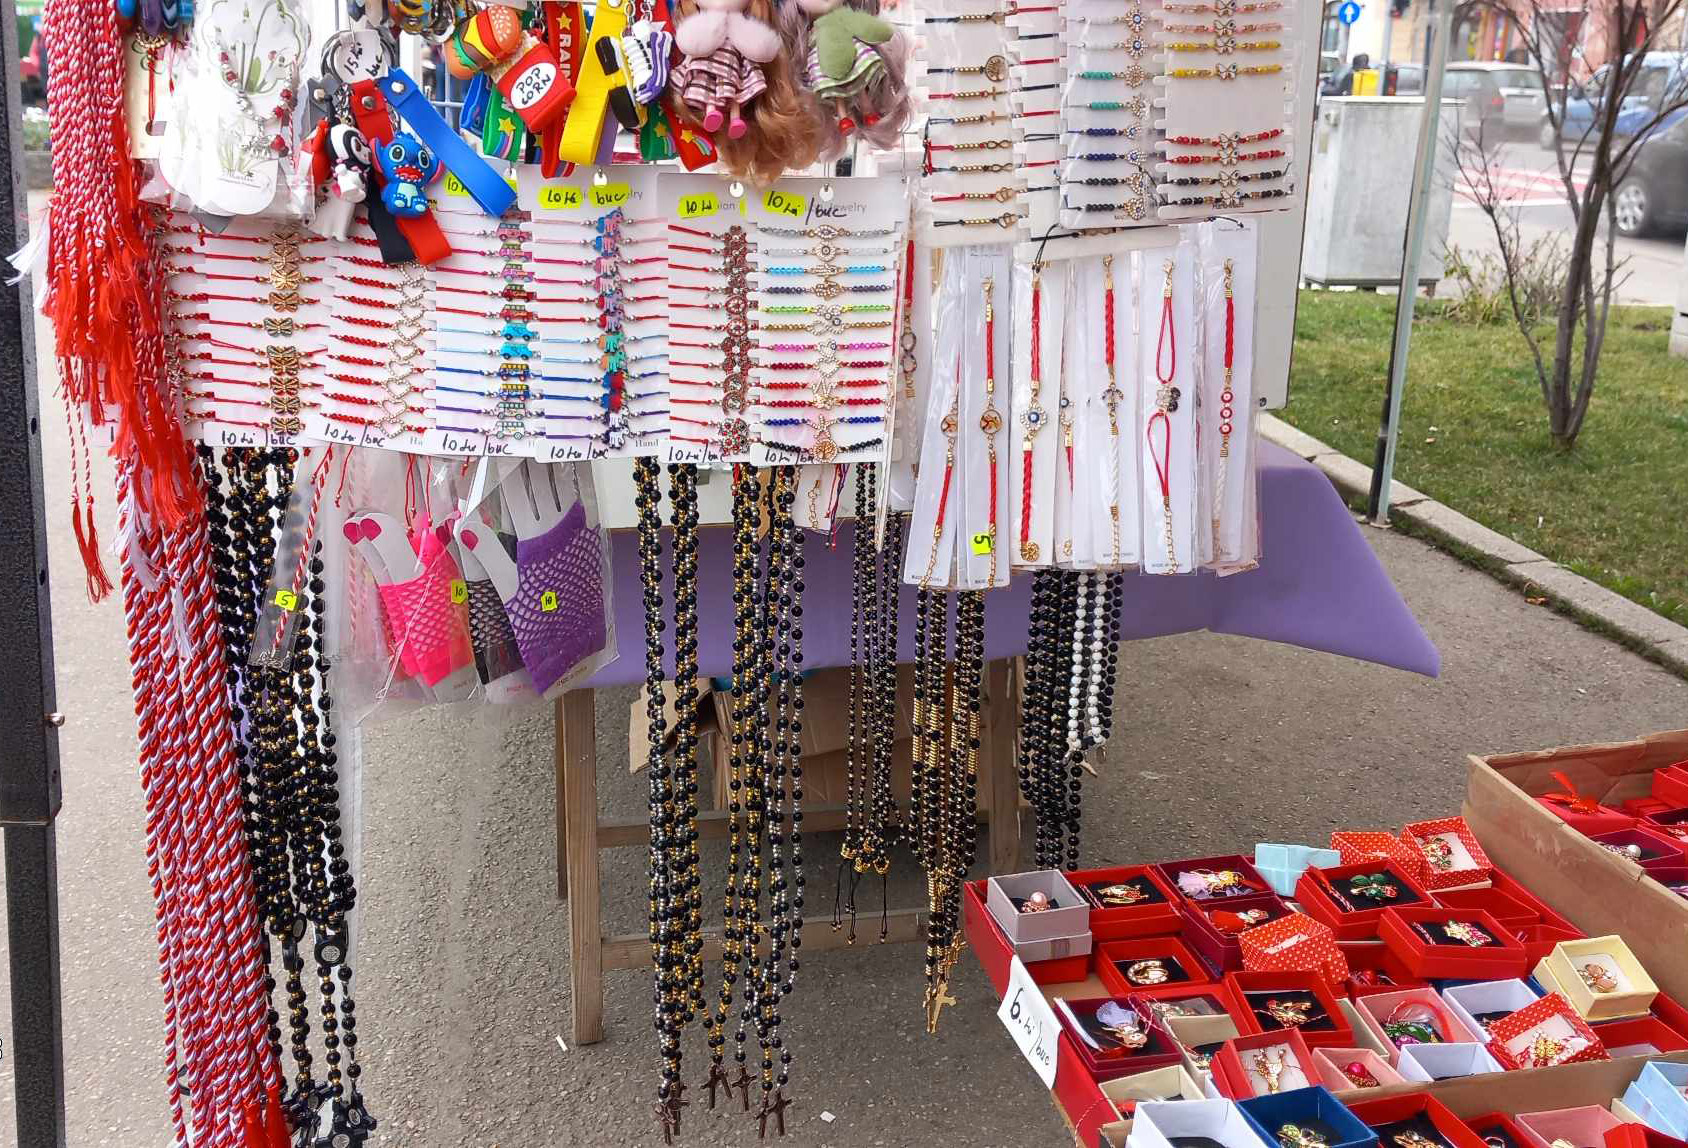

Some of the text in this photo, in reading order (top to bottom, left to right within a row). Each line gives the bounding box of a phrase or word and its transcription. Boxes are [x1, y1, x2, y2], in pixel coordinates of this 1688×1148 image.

[344, 57, 359, 76] 15
[515, 67, 541, 94] POP
[521, 74, 552, 106] CORN
[767, 191, 784, 208] 10
[221, 430, 237, 445] 10
[324, 423, 339, 439] 10
[442, 433, 458, 452] 10
[550, 446, 565, 459] 10
[668, 446, 684, 462] 10
[765, 449, 777, 463] 10
[281, 594, 294, 606] 5
